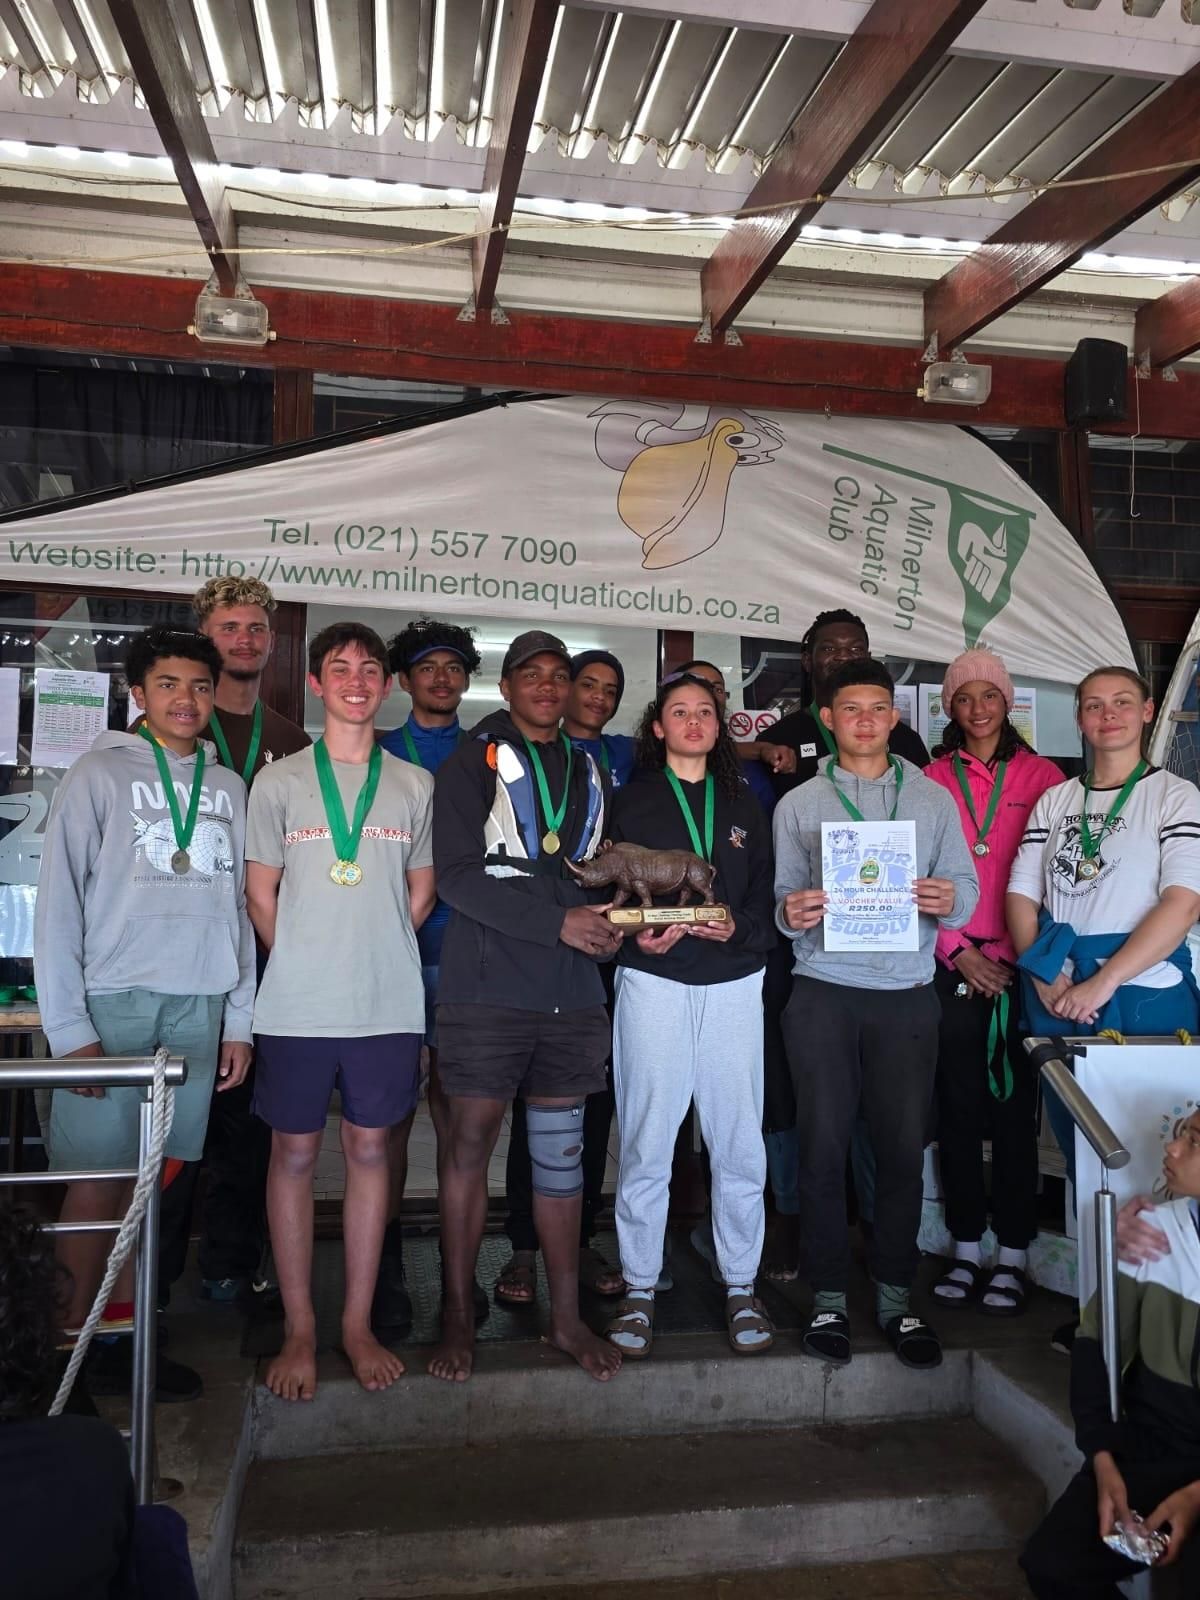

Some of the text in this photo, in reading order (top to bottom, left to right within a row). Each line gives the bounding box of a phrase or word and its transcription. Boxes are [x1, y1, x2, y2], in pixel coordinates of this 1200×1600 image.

[827, 476, 861, 542] Club
[263, 518, 577, 566] Tel. (021) 557 7090
[860, 483, 898, 596] Aquatic
[893, 496, 936, 631] Milnerton
[9, 540, 780, 625] Website: http://www.milnertonaquaticclub.co.za
[131, 780, 234, 819] NASA
[815, 1313, 838, 1321] NIKE
[902, 1317, 921, 1326] NIKE
